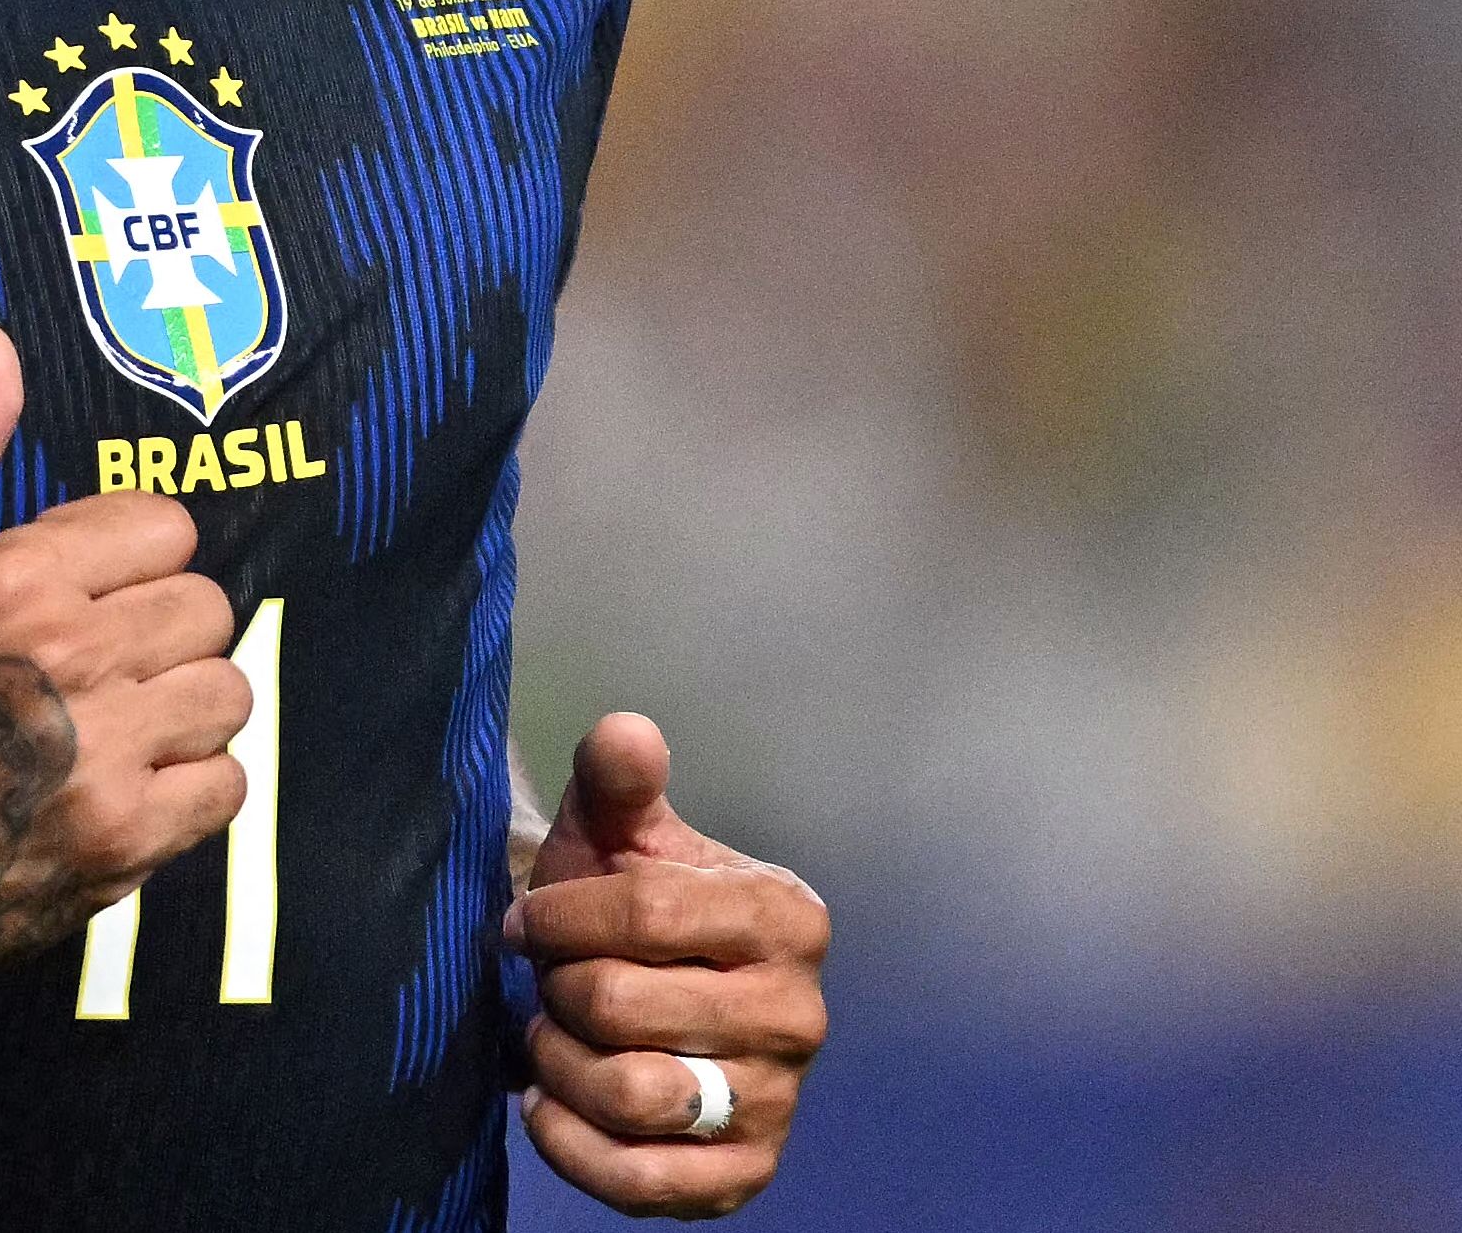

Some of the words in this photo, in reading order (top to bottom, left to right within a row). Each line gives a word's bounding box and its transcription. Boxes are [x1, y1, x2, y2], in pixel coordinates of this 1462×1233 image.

[469, 15, 489, 31] vs
[423, 35, 500, 60] Philadelphia
[506, 33, 539, 49] EUA
[124, 211, 201, 252] CBF
[96, 420, 327, 496] BRASIL
